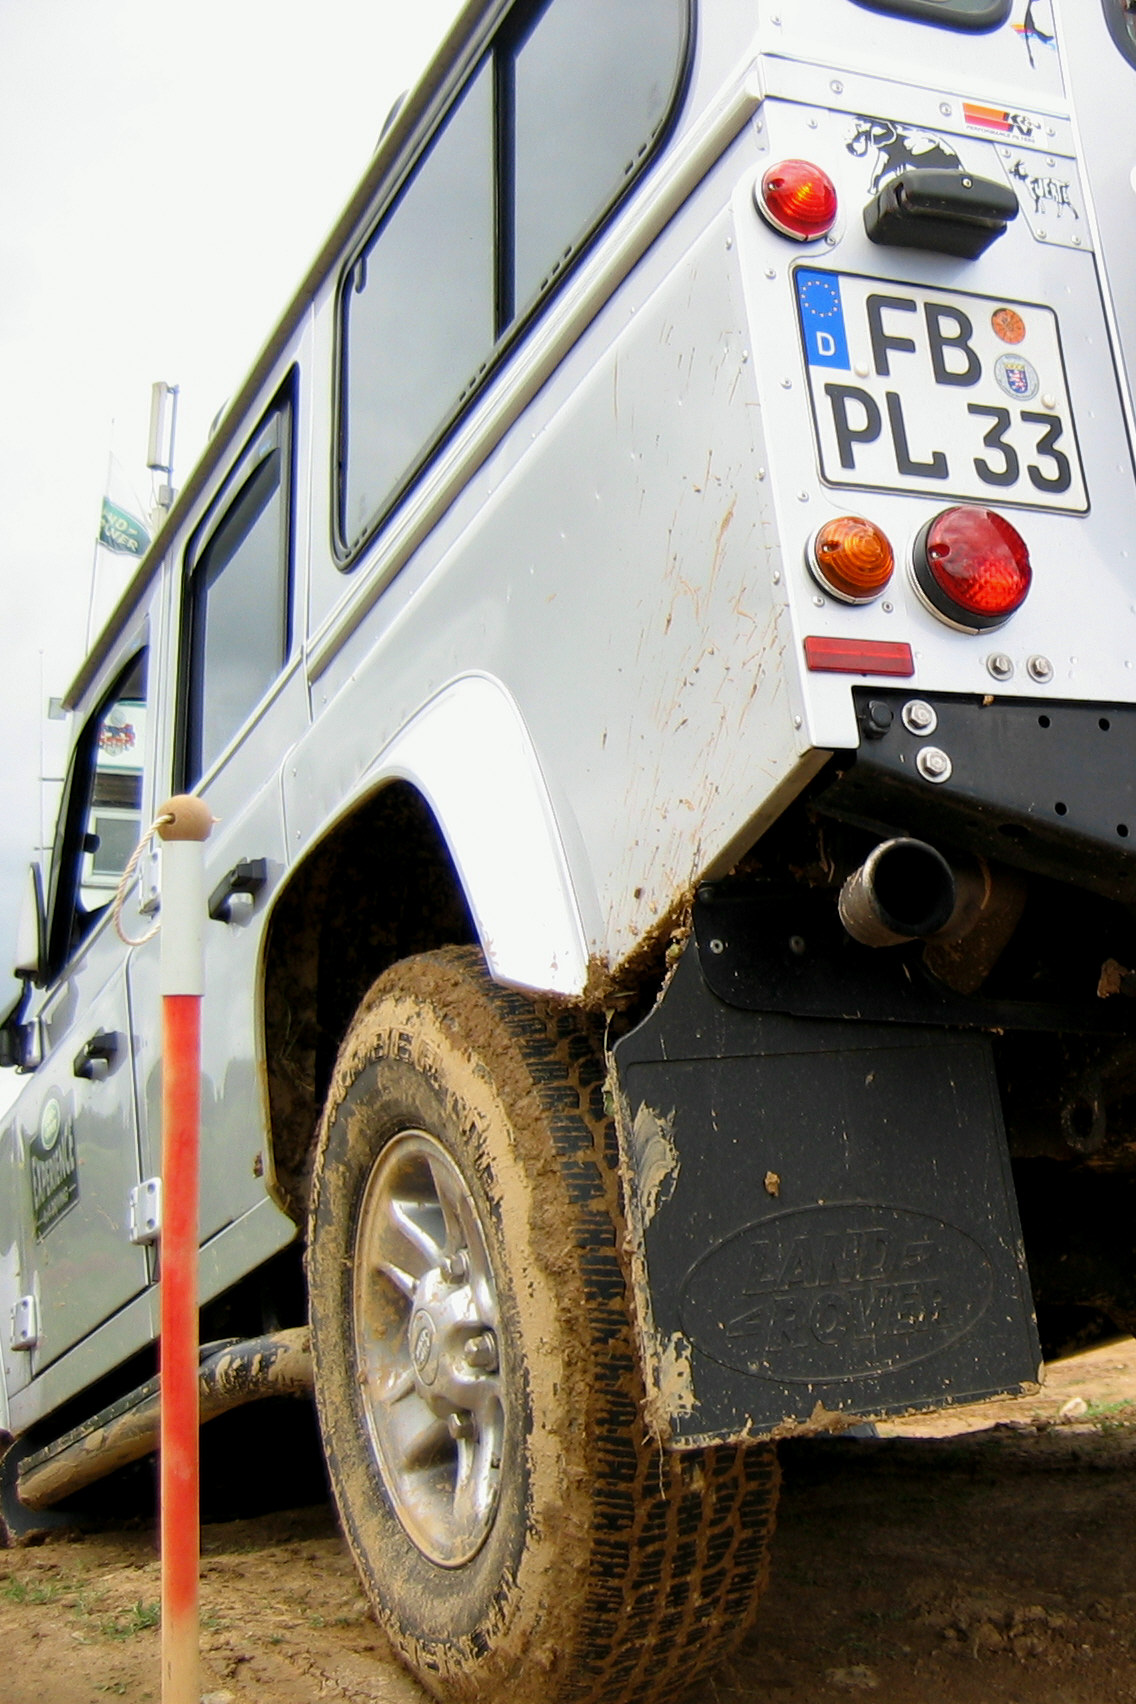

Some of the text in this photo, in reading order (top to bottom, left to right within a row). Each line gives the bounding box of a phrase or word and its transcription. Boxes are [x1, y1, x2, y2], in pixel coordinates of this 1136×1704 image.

[816, 332, 835, 357] D
[867, 294, 981, 387] FB
[825, 383, 1072, 493] PL 33
[741, 1228, 889, 1296] LAND
[764, 1278, 954, 1352] ROVER
